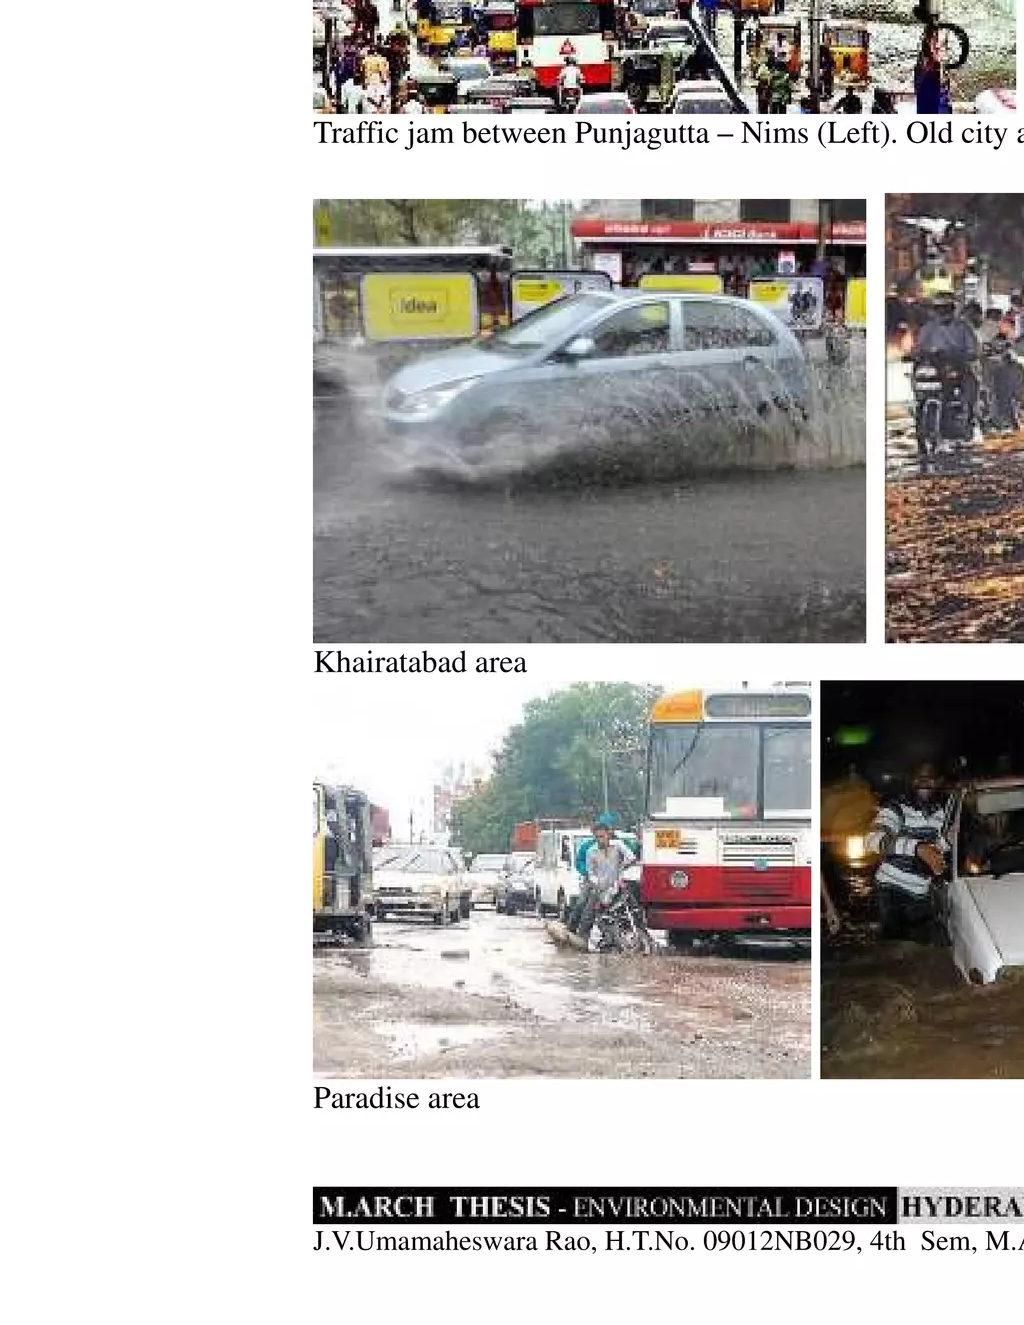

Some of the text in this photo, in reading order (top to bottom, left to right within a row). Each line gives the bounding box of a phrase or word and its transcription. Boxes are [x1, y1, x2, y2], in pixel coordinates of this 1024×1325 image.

[313, 120, 399, 144] Traffic
[404, 120, 455, 151] jam
[461, 120, 567, 144] between
[574, 120, 710, 151] Punjagutta
[741, 120, 809, 144] Nims
[817, 120, 897, 149] (Left).
[906, 120, 954, 144] Old
[961, 120, 1008, 151] city
[314, 650, 528, 673] Khairatabad area
[313, 1085, 481, 1109] Paradise area
[320, 1196, 434, 1218] M.ARCH
[449, 1196, 550, 1218] THESIS
[574, 1196, 787, 1218] ENVIRONMENTAL
[795, 1196, 888, 1218] DESIGN
[312, 1230, 539, 1251] J.V.Umamaheswara
[545, 1230, 597, 1255] Rao,
[605, 1230, 695, 1251] H.T.No.
[703, 1230, 862, 1255] 09012NB029,
[869, 1230, 906, 1251] 4th
[921, 1230, 977, 1255] Sem,
